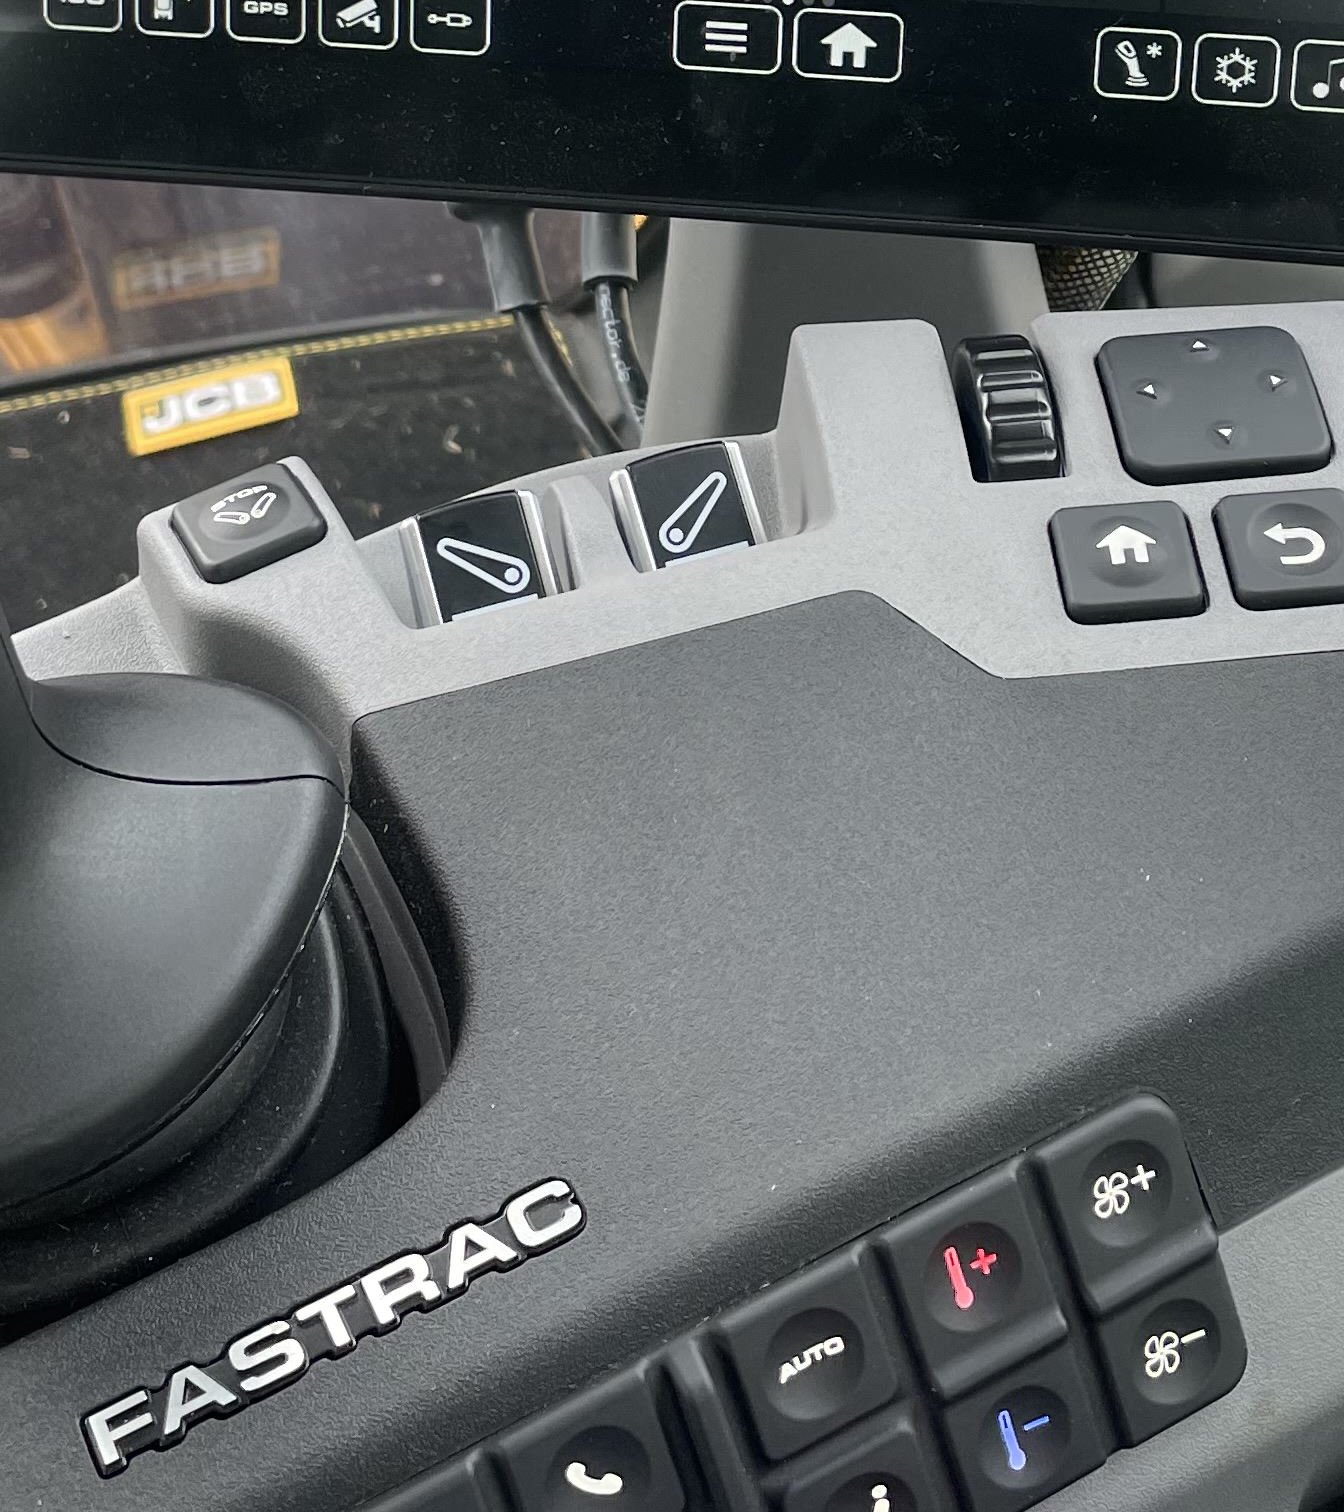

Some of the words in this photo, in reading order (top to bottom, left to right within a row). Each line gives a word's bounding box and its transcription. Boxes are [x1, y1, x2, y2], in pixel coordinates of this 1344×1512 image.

[243, 0, 289, 16] GPS
[141, 370, 281, 434] JCB
[86, 1180, 583, 1466] FASTRAC
[778, 1336, 845, 1384] AUTO
